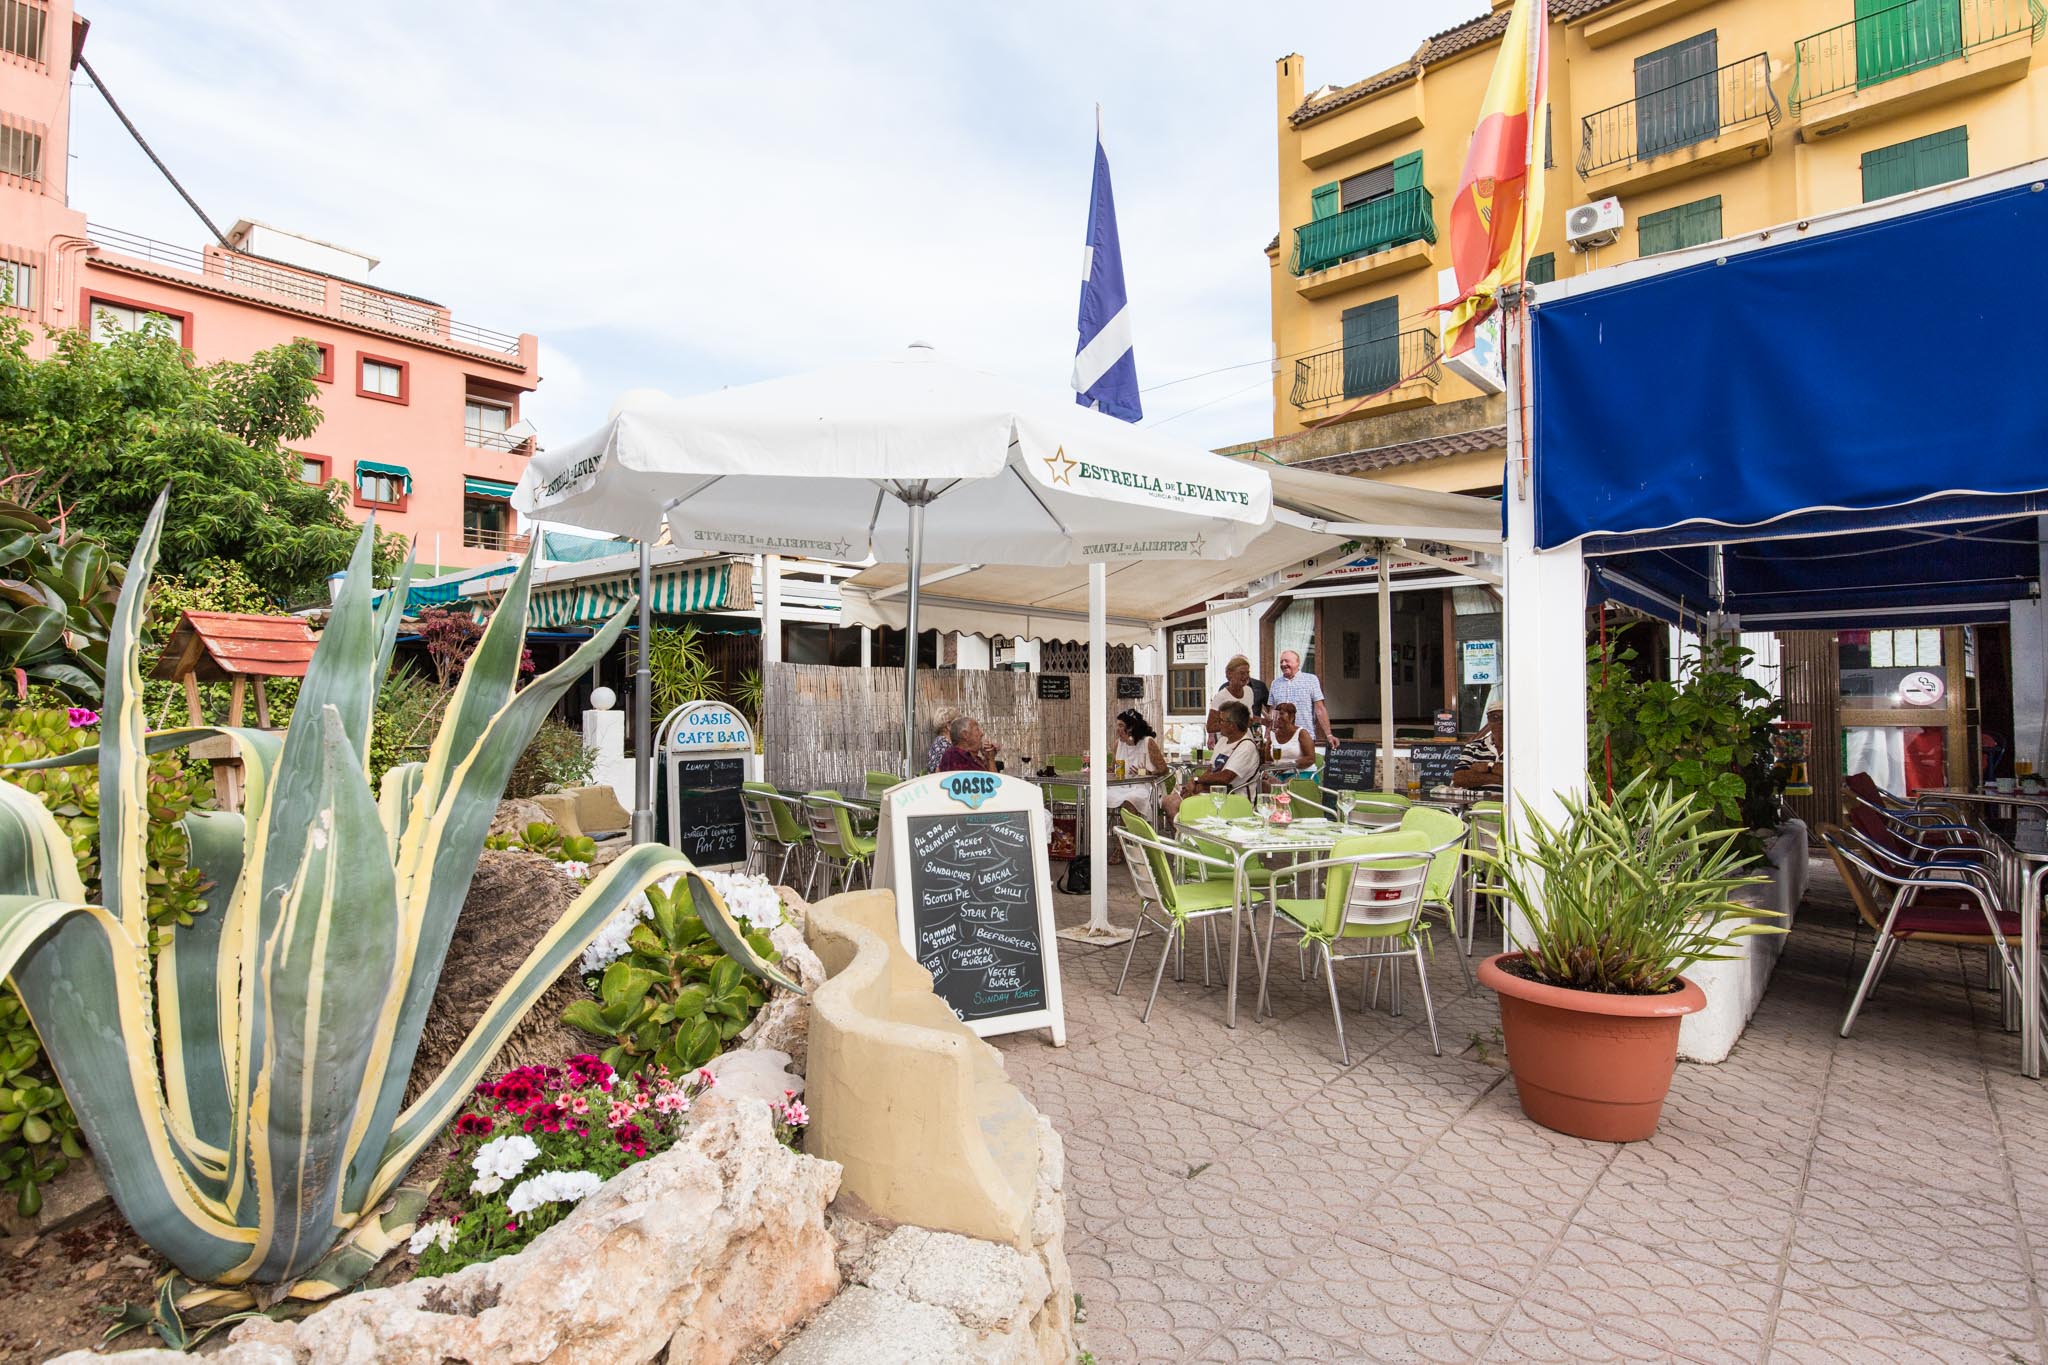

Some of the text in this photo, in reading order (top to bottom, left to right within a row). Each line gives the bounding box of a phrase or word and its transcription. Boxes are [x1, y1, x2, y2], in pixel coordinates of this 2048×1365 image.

[1078, 462, 1249, 505] ESTRELLA DE LEVANTE
[1177, 635, 1185, 643] SE
[689, 713, 731, 726] OASIS
[677, 730, 746, 744] CAFE BAR
[951, 776, 995, 795] OASIS
[991, 824, 1025, 842] TOASTIES
[919, 825, 957, 857] BREAKFAST
[954, 837, 983, 848] JACKET
[978, 867, 1012, 885] LASAGNA
[924, 888, 971, 906] SCOTCH PIE
[994, 886, 1021, 898] CHILLI
[960, 902, 1006, 921] STEAK PIE
[932, 934, 957, 949] STEAK
[976, 928, 1037, 951] BEEFBURGERS
[951, 947, 991, 960] CHICKEN
[961, 954, 993, 967] BURGER
[988, 966, 1017, 977] VEGGIE
[988, 978, 1021, 988] BURGER
[973, 988, 1040, 1005] SUNDAY ROAST
